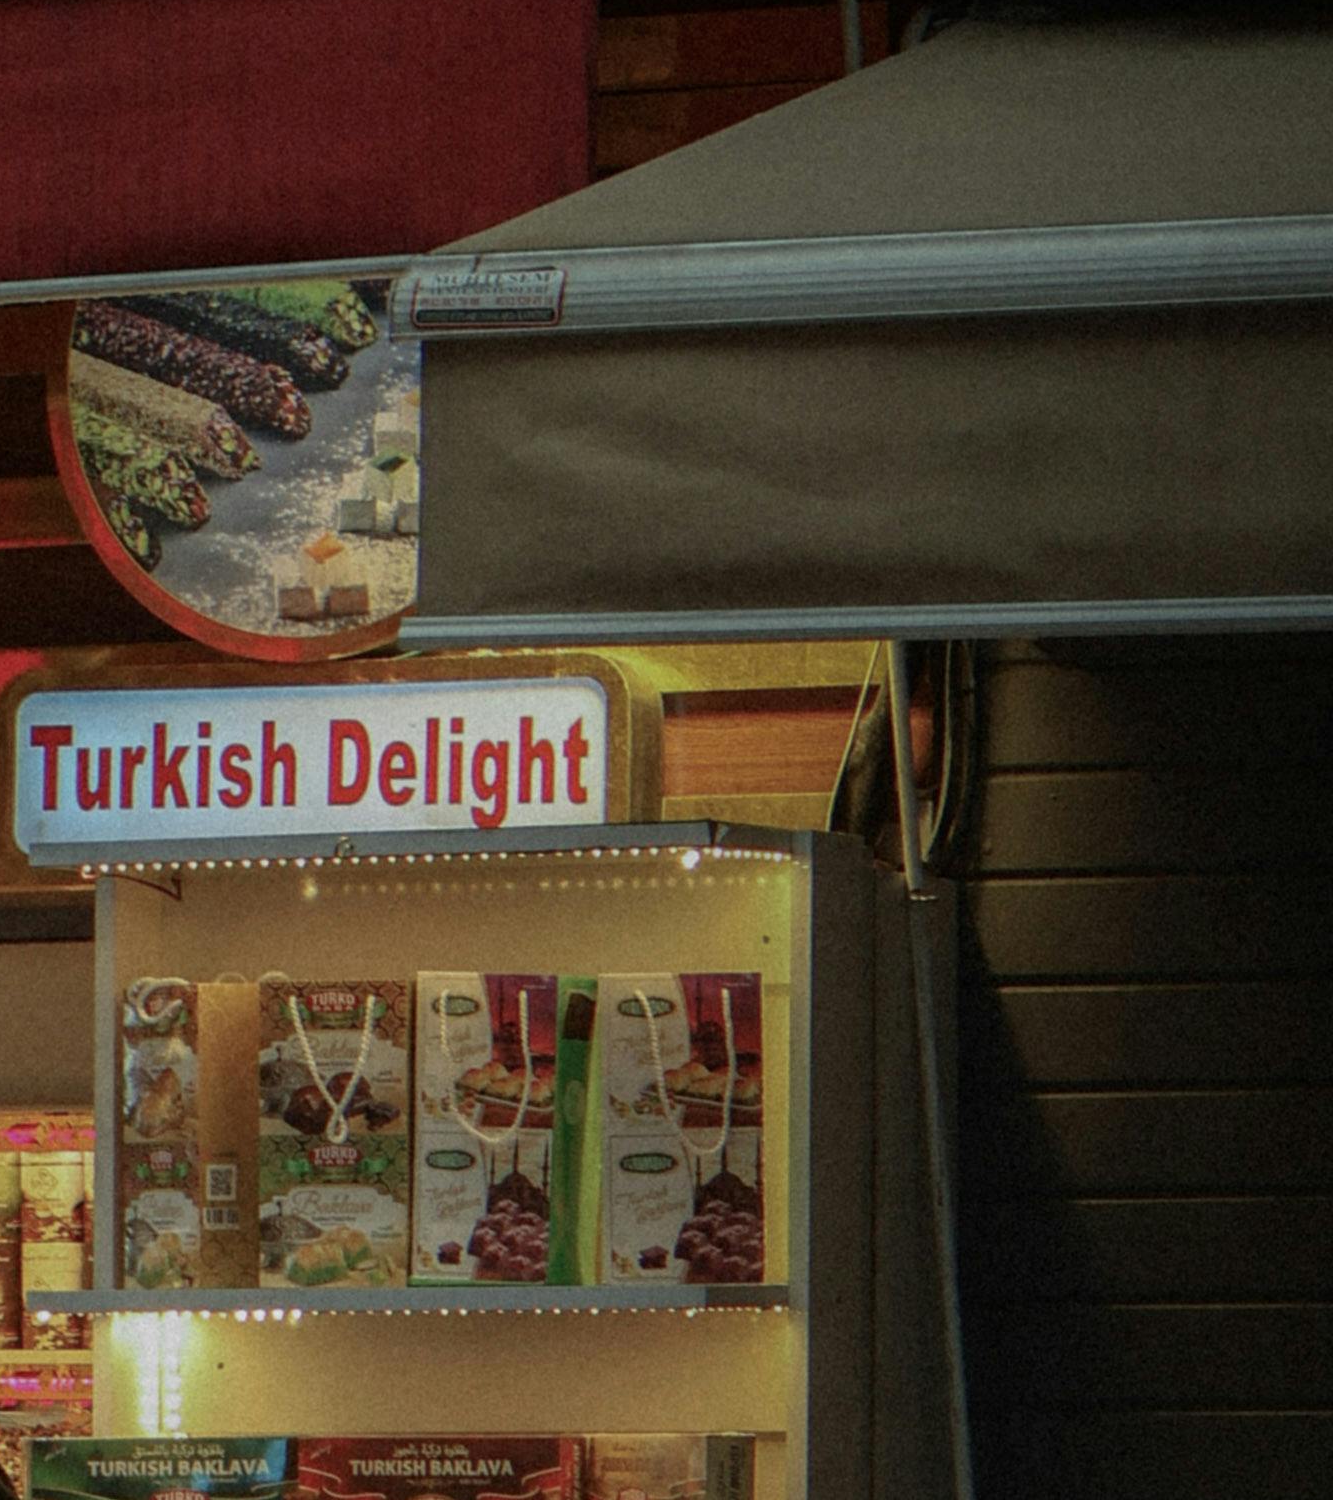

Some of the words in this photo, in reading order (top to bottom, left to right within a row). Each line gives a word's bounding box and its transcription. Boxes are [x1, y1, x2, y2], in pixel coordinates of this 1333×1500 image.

[32, 720, 301, 811] Turkish
[328, 713, 599, 826] Delight
[87, 1460, 173, 1477] TURKISH
[178, 1459, 271, 1476] BAKLAVA
[349, 1459, 427, 1477] TURKISH
[429, 1458, 514, 1477] BAKLAVA
